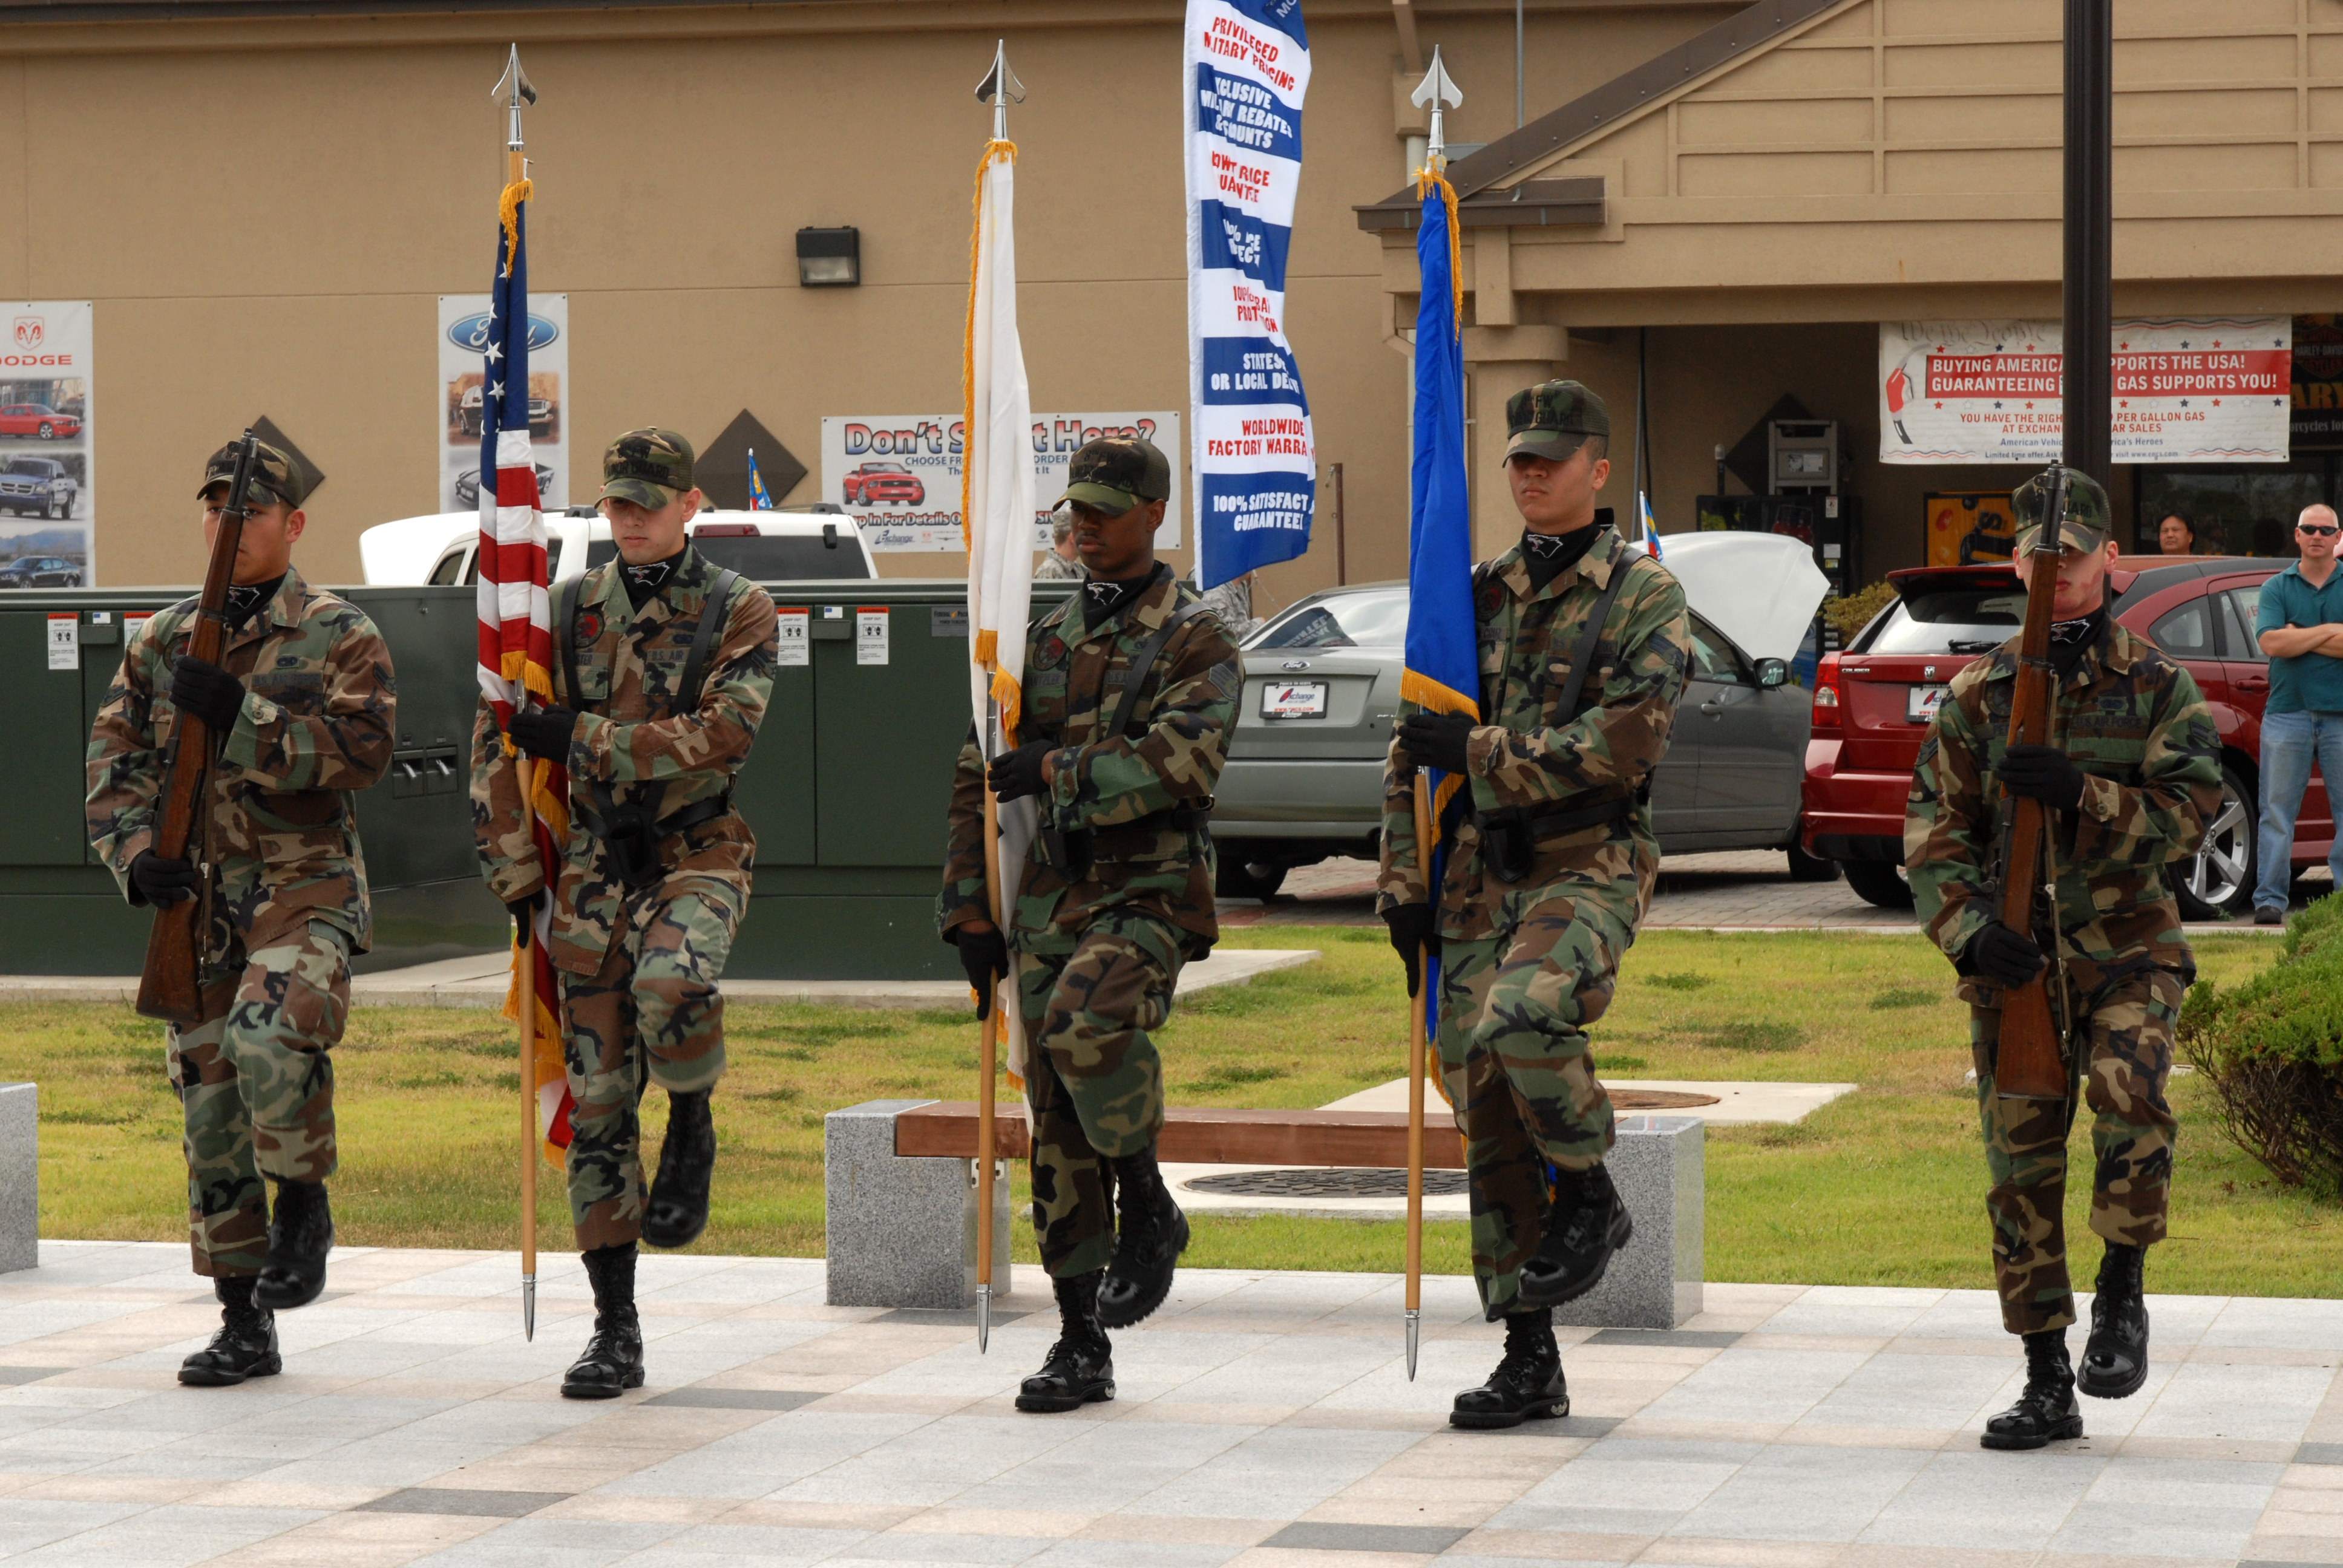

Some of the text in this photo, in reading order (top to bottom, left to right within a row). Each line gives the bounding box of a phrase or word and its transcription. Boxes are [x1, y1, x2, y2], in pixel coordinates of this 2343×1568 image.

[1212, 17, 1279, 62] PRIVILEGED
[1253, 54, 1295, 91] PRICING
[1215, 77, 1272, 109] XCLUSIVE
[1239, 165, 1270, 186] RICE
[0, 355, 72, 366] ODGE
[1933, 359, 1991, 373] BUYING
[2171, 355, 2203, 370] THE
[2208, 354, 2245, 369] USA!
[1211, 373, 1230, 390] OR
[1235, 373, 1268, 390] LOCAL
[1932, 377, 2056, 393] GUARANTEEING
[2117, 376, 2148, 390] GAS
[2152, 374, 2236, 390] SUPPORTS
[2240, 374, 2277, 388] YOU!
[1961, 411, 2206, 423] YOU HAVE THE RIGH PER GALLON GAS
[1242, 419, 1305, 436] WORLDWIDE
[2002, 423, 2162, 433] AT EXCHAN AR SALES
[845, 422, 942, 454] Don't
[2001, 438, 2039, 446] American
[2041, 438, 2063, 446] Vehic
[2135, 437, 2163, 446] Heroes
[1208, 439, 1262, 456] FACTORY
[905, 456, 946, 465] CHOOSE
[1213, 495, 1248, 512] 100%
[868, 512, 883, 527] In
[883, 512, 906, 526] For
[905, 511, 951, 526] Details
[669, 650, 683, 661] AIR
